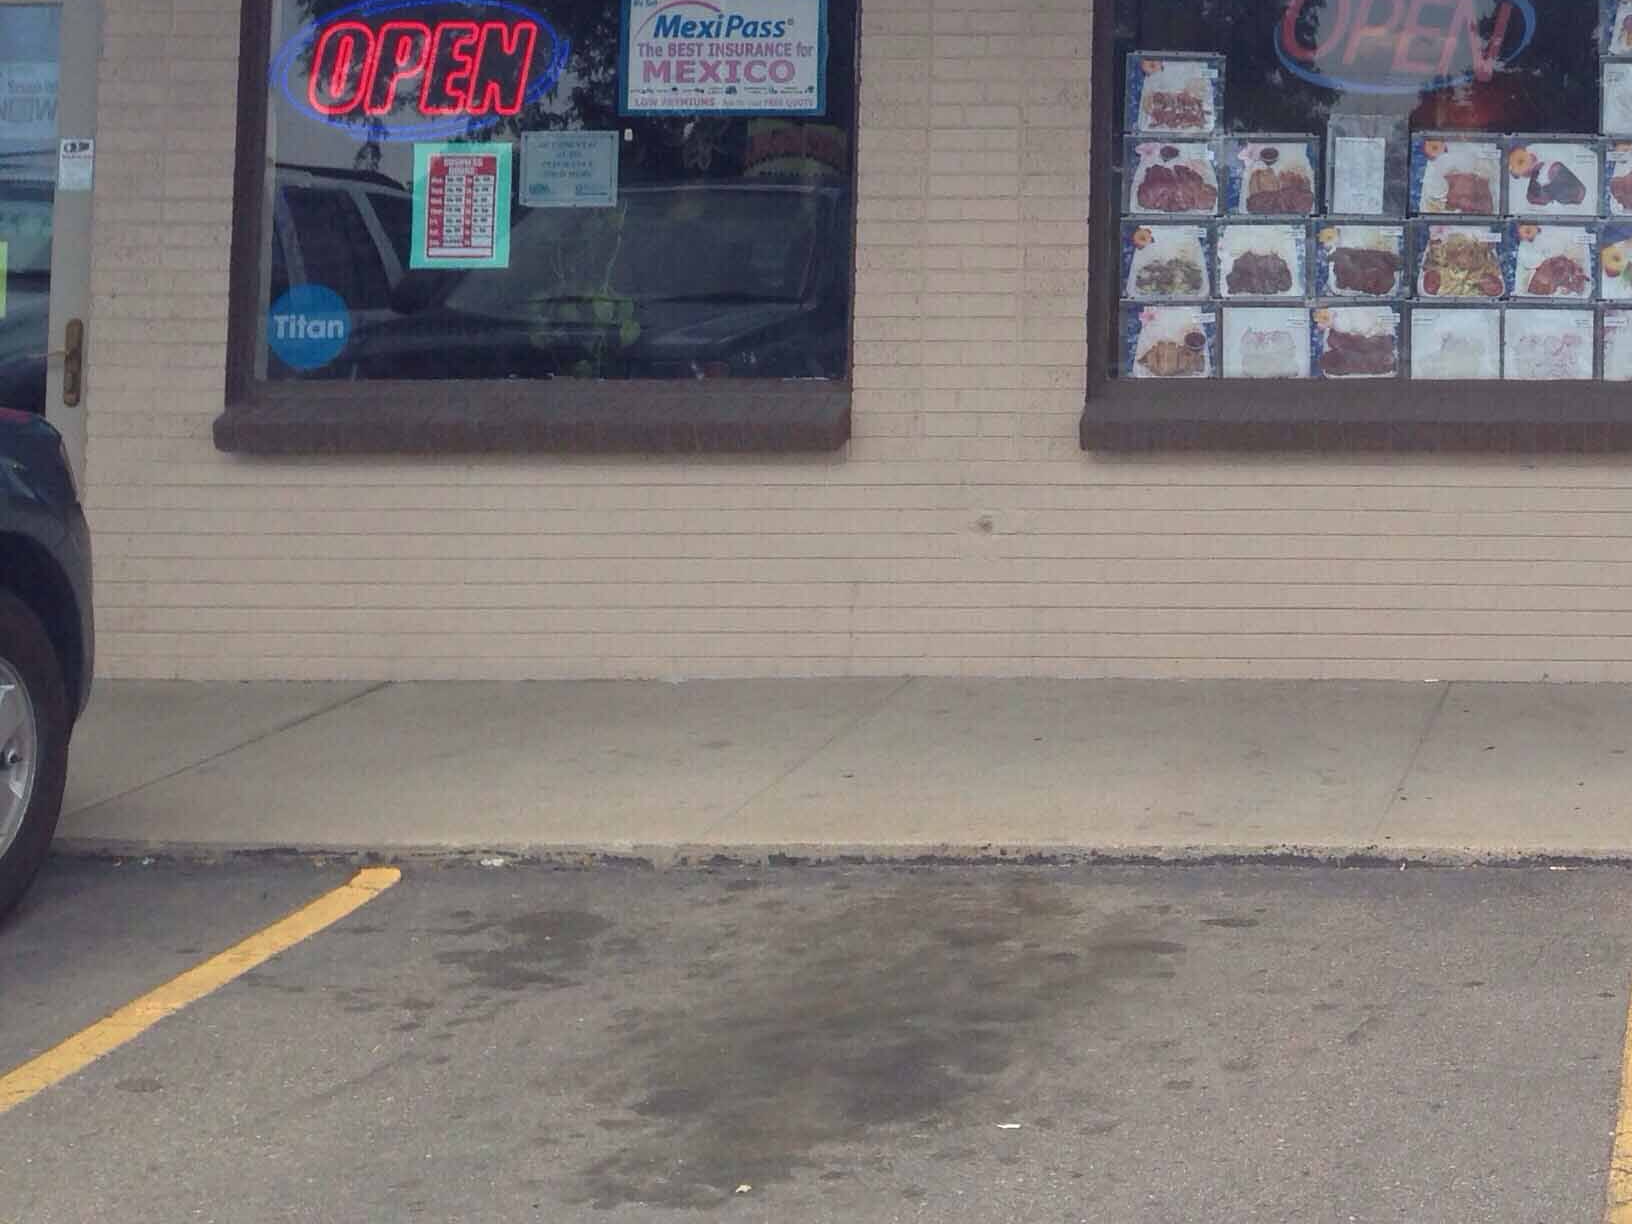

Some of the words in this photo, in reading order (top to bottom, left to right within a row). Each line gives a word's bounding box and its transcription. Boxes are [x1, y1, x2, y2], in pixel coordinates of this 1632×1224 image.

[638, 42, 664, 57] The
[667, 42, 703, 57] BEST
[707, 42, 793, 57] INSURANCE
[796, 42, 815, 57] for
[307, 19, 538, 116] OPEN
[642, 58, 797, 84] MEXICO
[273, 313, 345, 339] Titan
